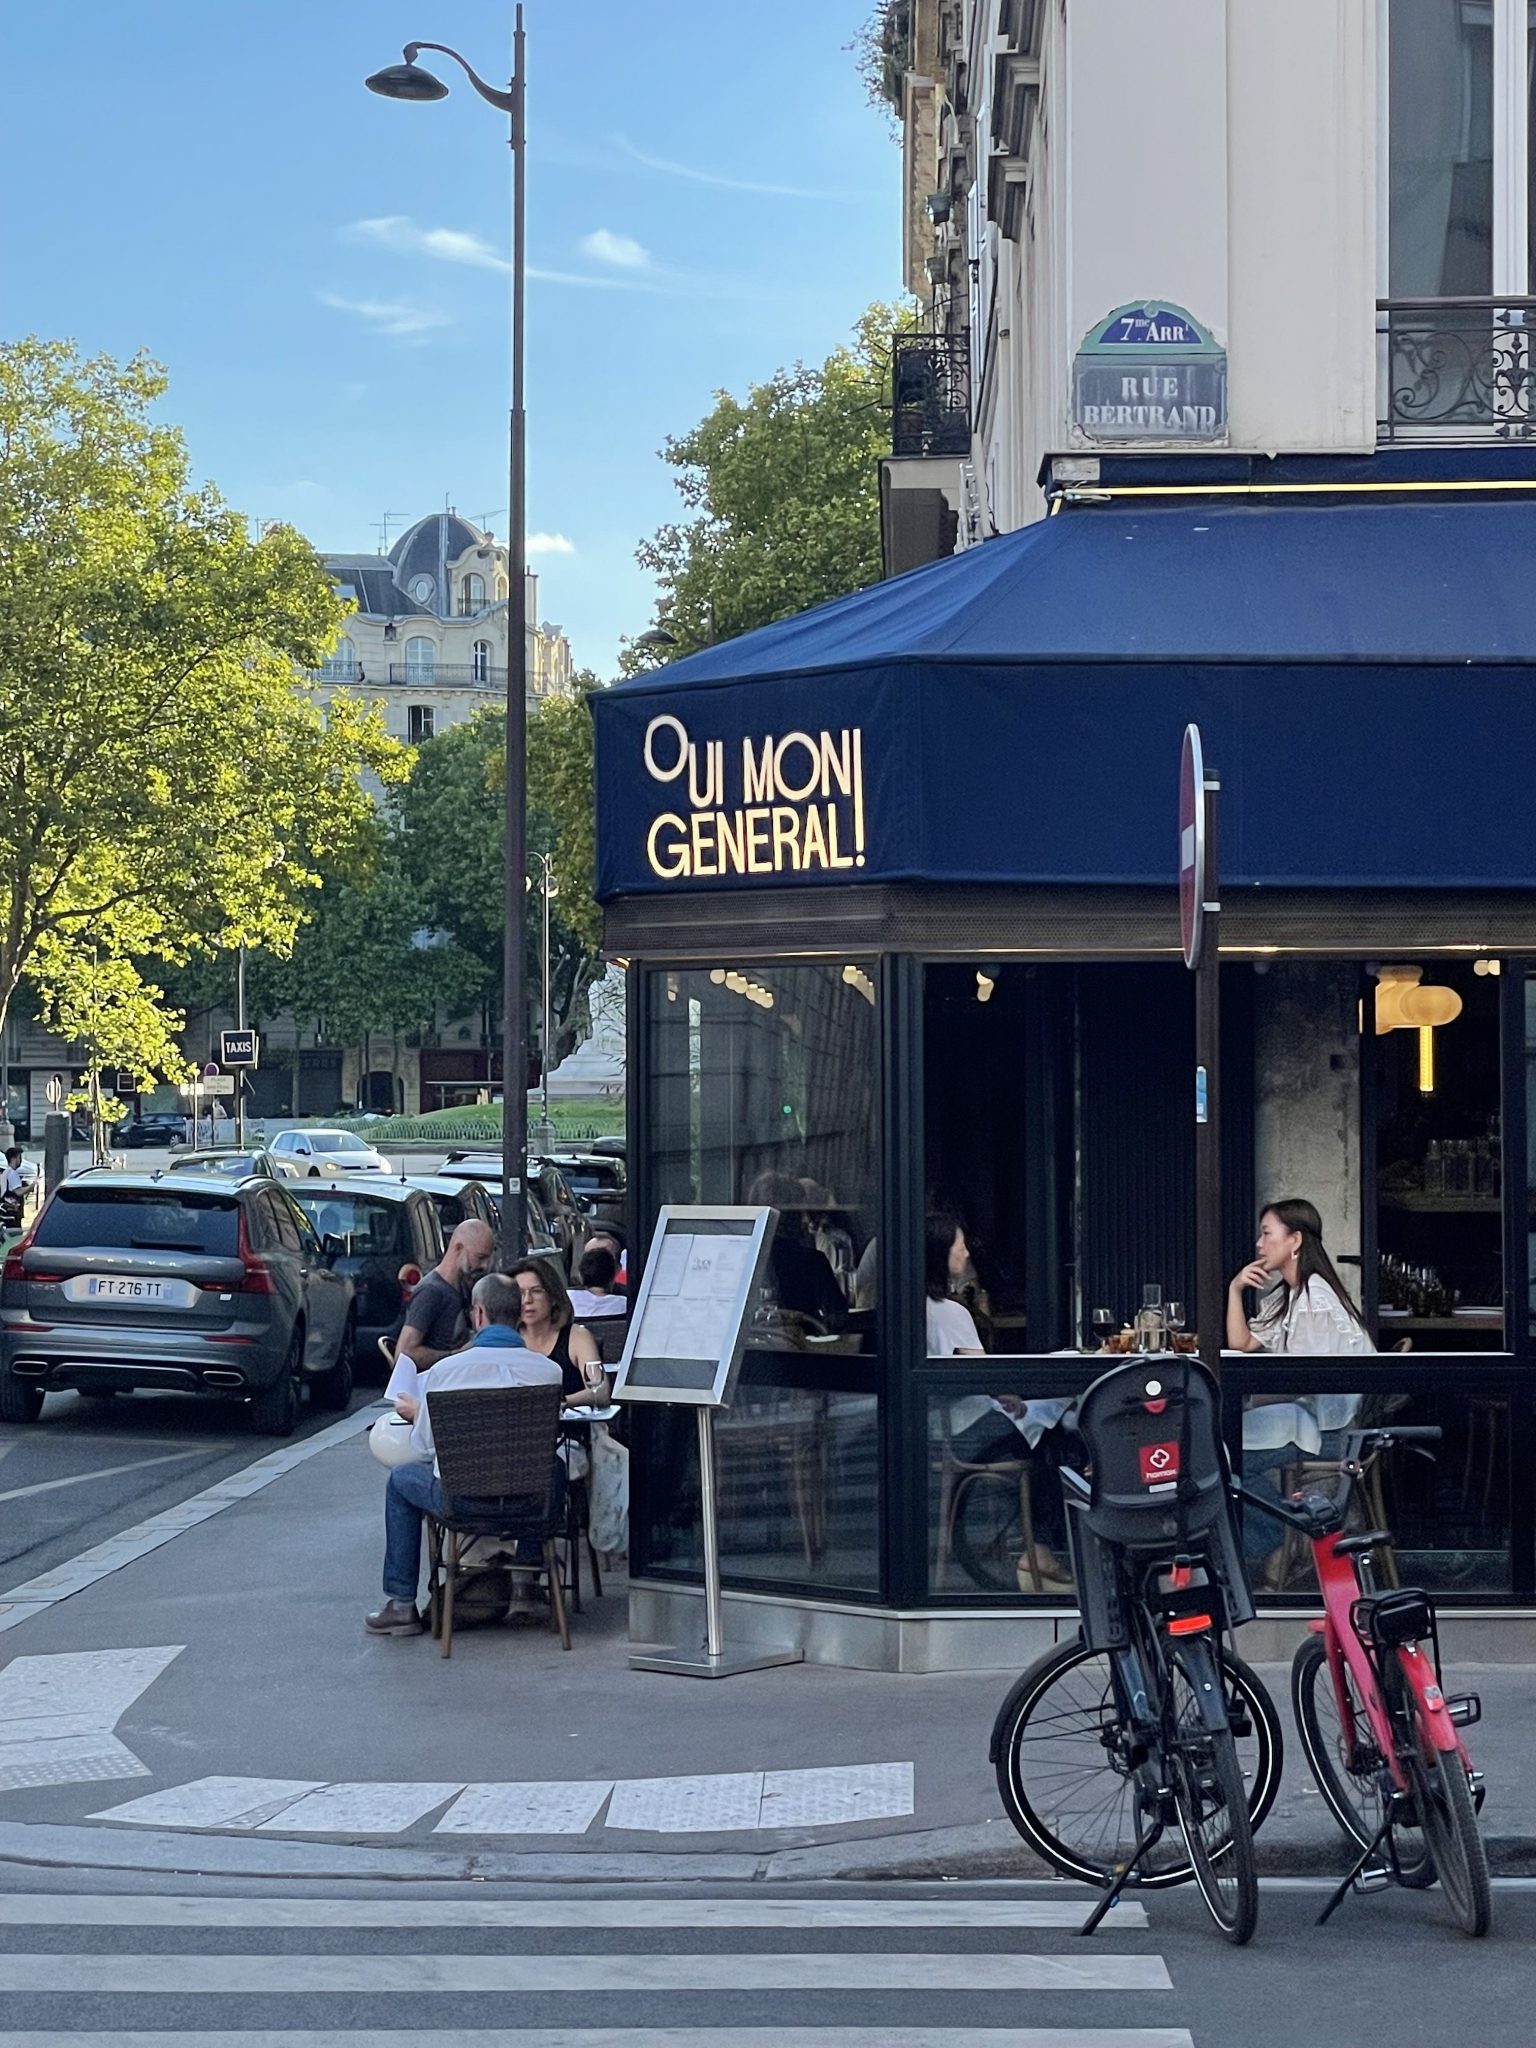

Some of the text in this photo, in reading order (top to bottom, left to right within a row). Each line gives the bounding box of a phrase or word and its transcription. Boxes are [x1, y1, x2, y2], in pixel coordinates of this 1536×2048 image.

[1121, 377, 1178, 398] RUE
[1084, 405, 1216, 433] BERTRAND
[225, 1041, 252, 1054] TAXIS
